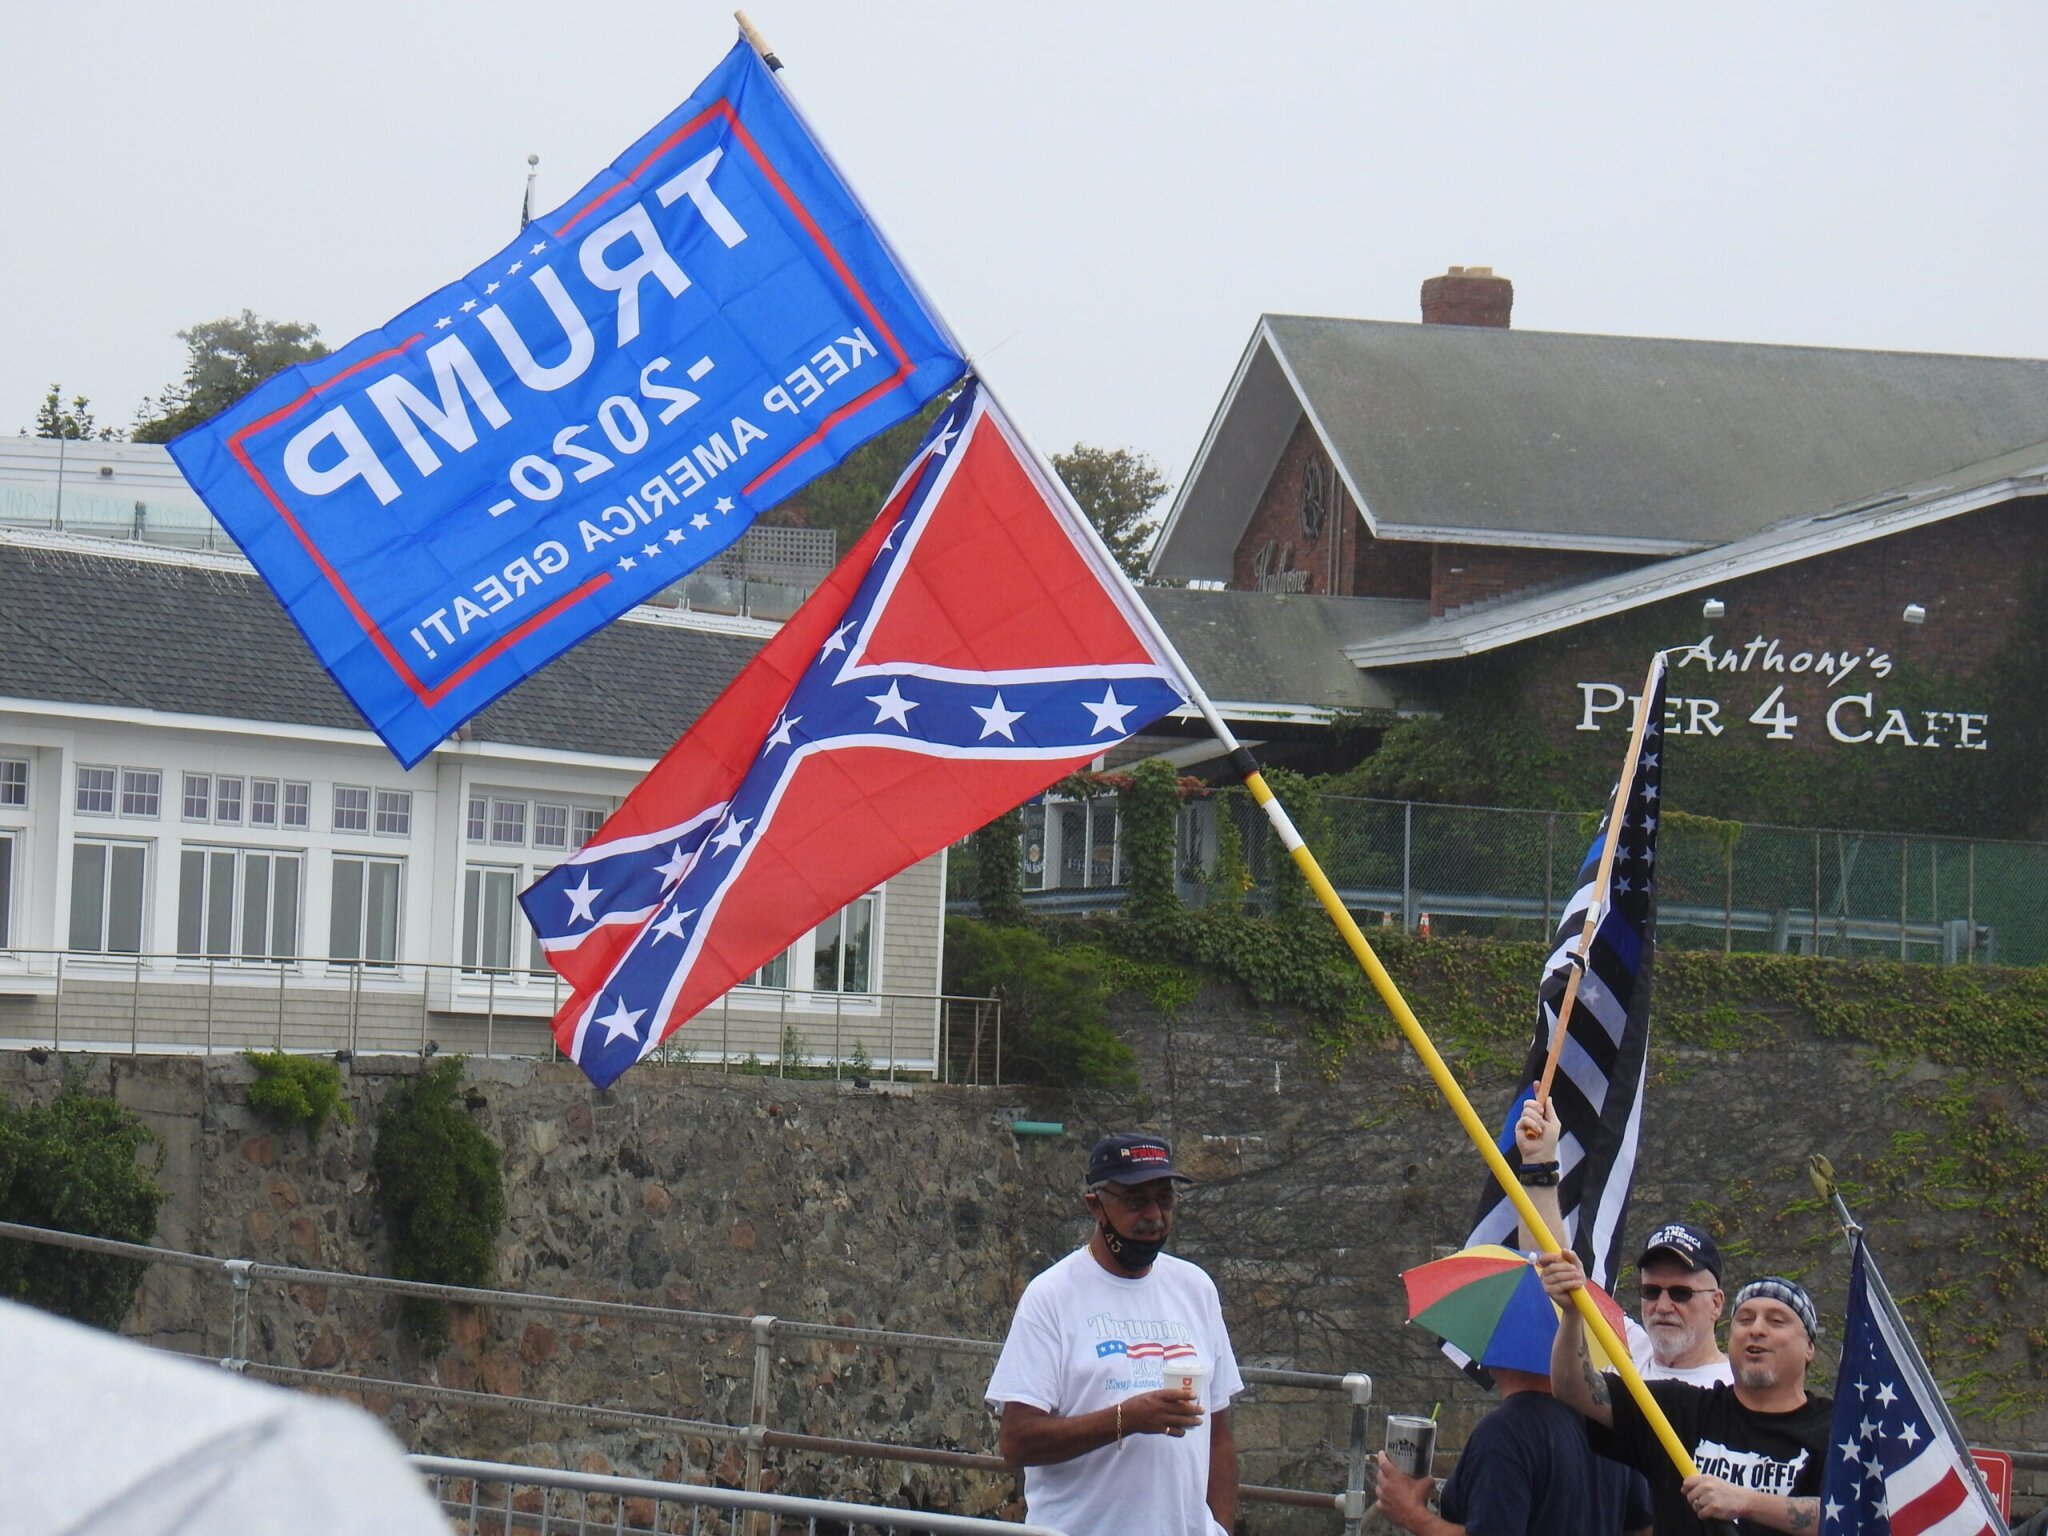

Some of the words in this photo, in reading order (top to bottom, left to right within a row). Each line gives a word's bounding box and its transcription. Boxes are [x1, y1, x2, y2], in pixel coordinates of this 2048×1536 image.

[1678, 634, 1893, 688] Anthony's
[1748, 684, 1798, 740] 4
[1664, 1230, 1701, 1250] AMERICA
[1087, 1311, 1191, 1346] Trump
[1751, 1462, 1796, 1489] OFF!
